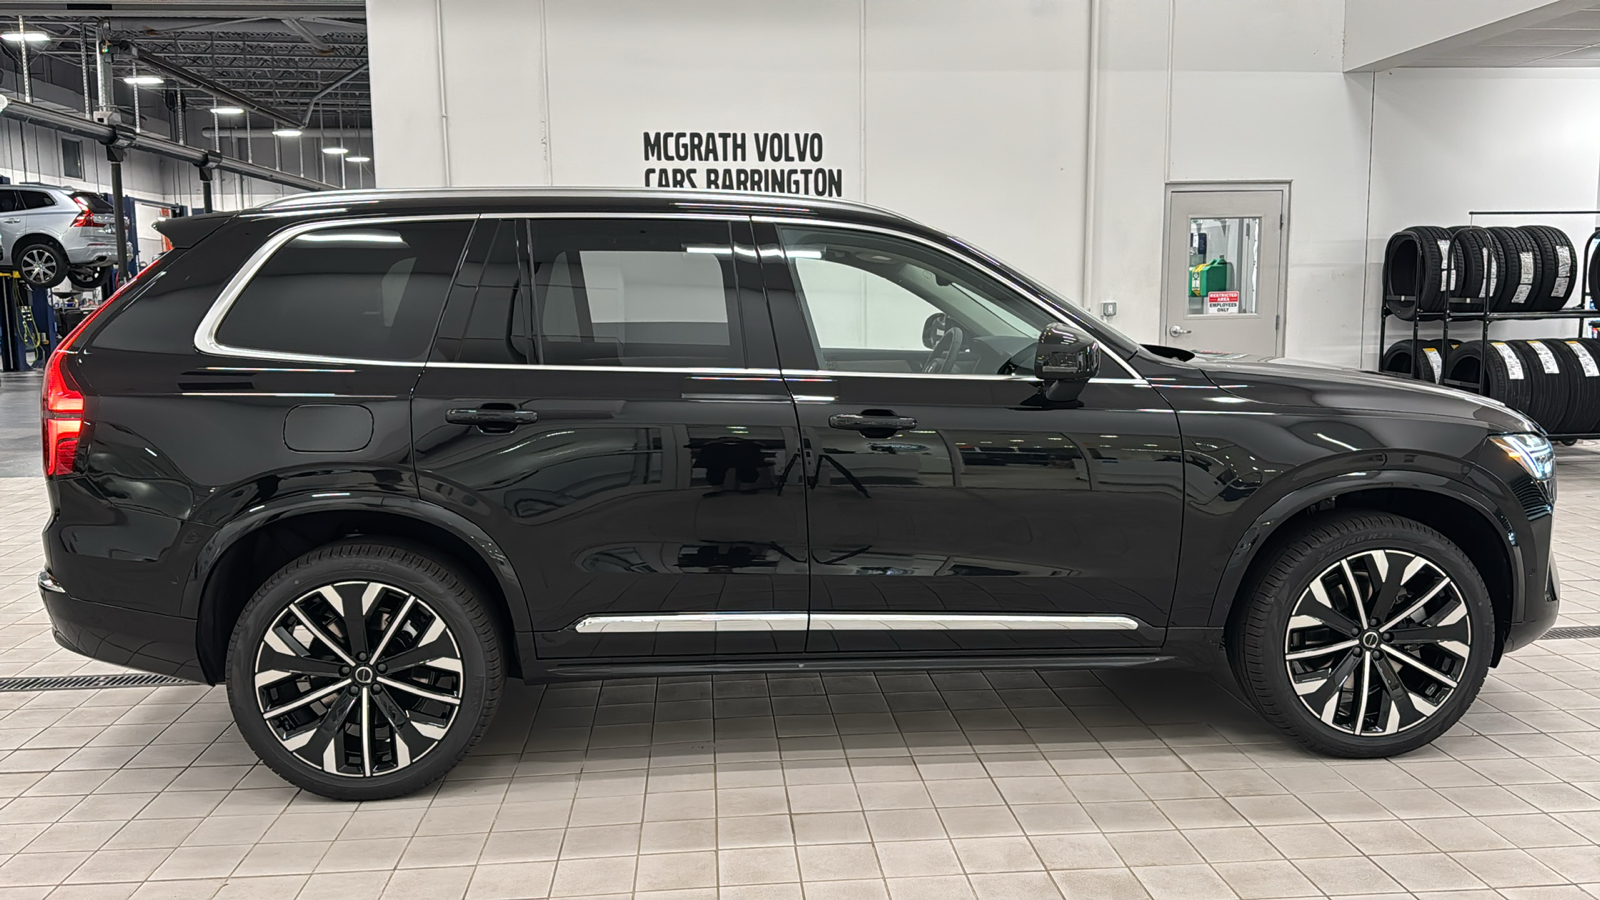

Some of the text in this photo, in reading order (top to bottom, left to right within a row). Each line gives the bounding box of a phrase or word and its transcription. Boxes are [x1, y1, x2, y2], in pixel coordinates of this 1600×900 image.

[643, 131, 823, 162] MCGRATH VOLVO
[706, 167, 842, 197] BARRINGTON
